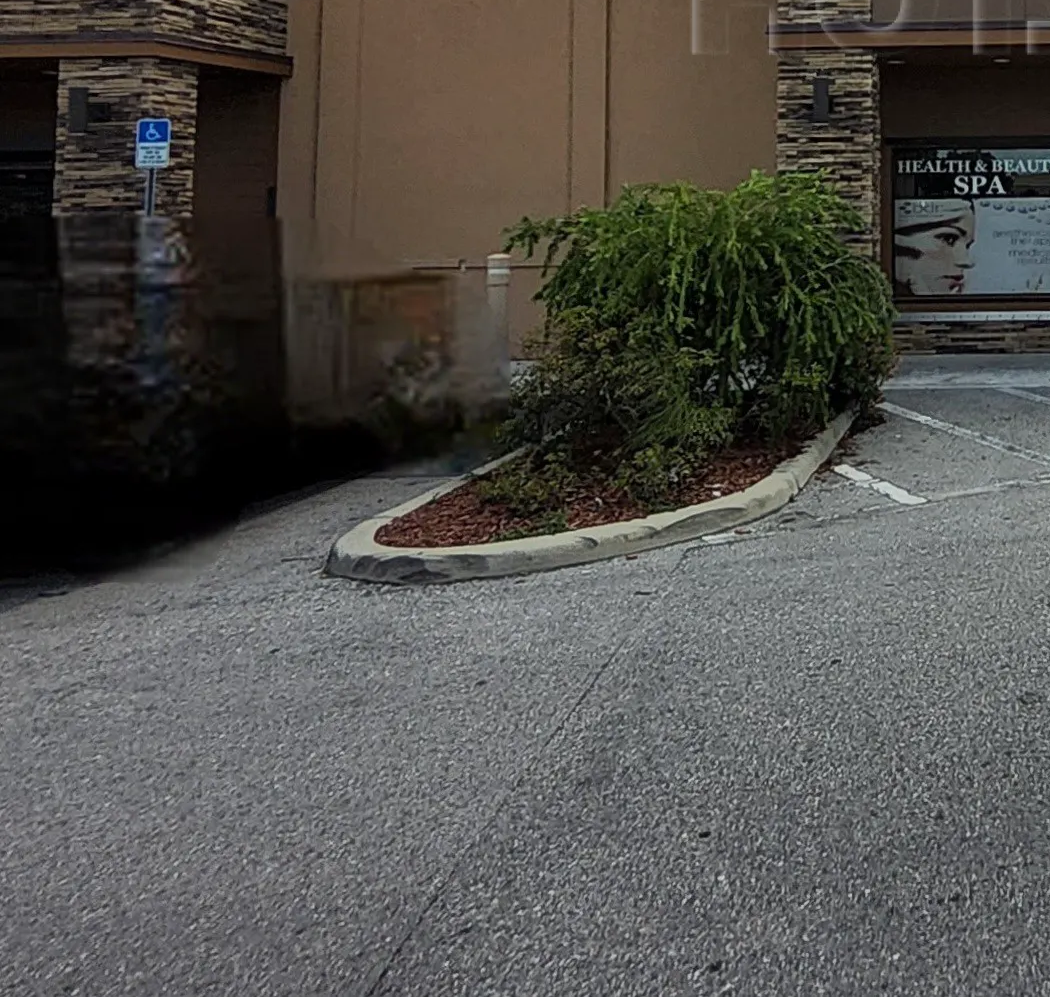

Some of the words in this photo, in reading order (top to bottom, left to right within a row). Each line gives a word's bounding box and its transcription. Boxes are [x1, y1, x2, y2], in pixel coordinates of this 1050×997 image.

[897, 159, 972, 173] HEALTH
[974, 159, 988, 173] &
[953, 175, 1007, 196] SPA
